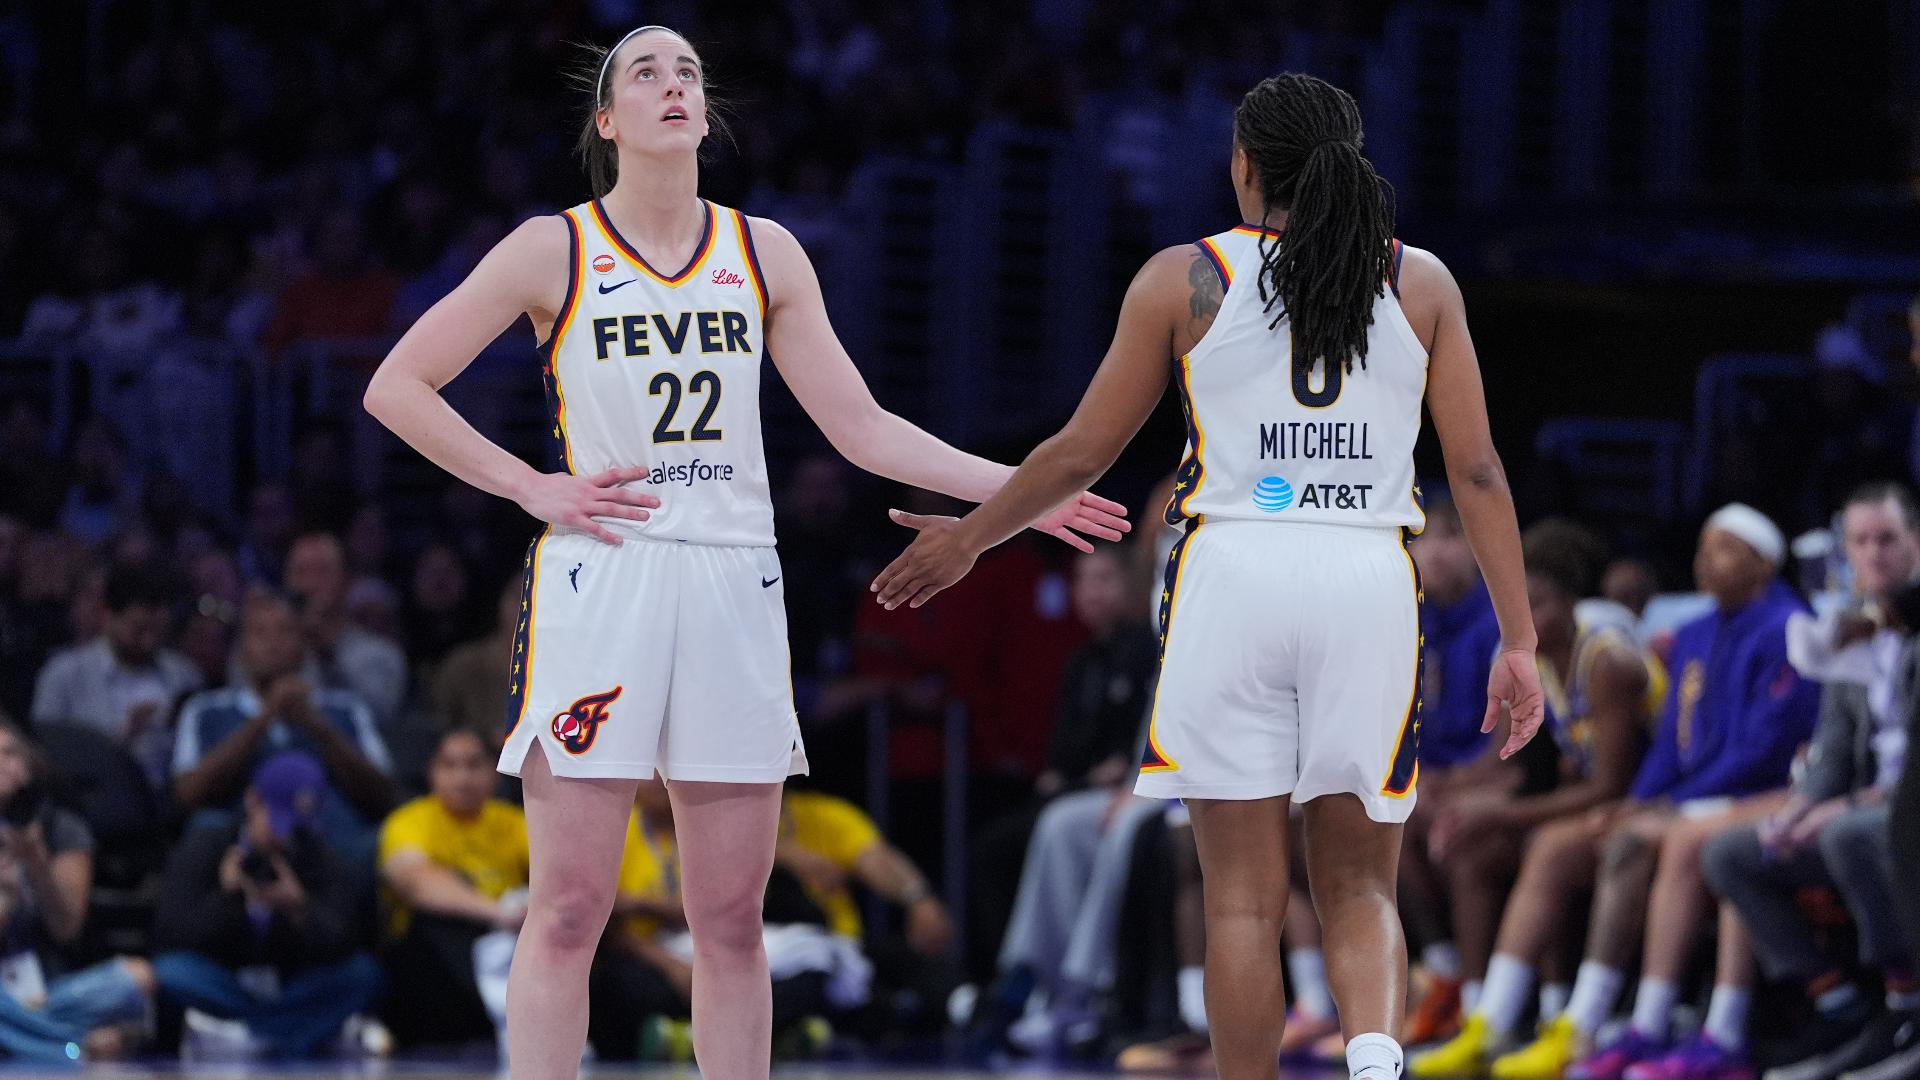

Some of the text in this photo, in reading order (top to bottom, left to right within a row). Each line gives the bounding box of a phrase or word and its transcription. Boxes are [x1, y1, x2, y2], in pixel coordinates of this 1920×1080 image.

[712, 268, 745, 289] Lilly
[593, 311, 753, 361] FEVER
[648, 369, 724, 444] 22
[1260, 422, 1373, 460] MITCHELL
[1298, 483, 1373, 509] AT&T
